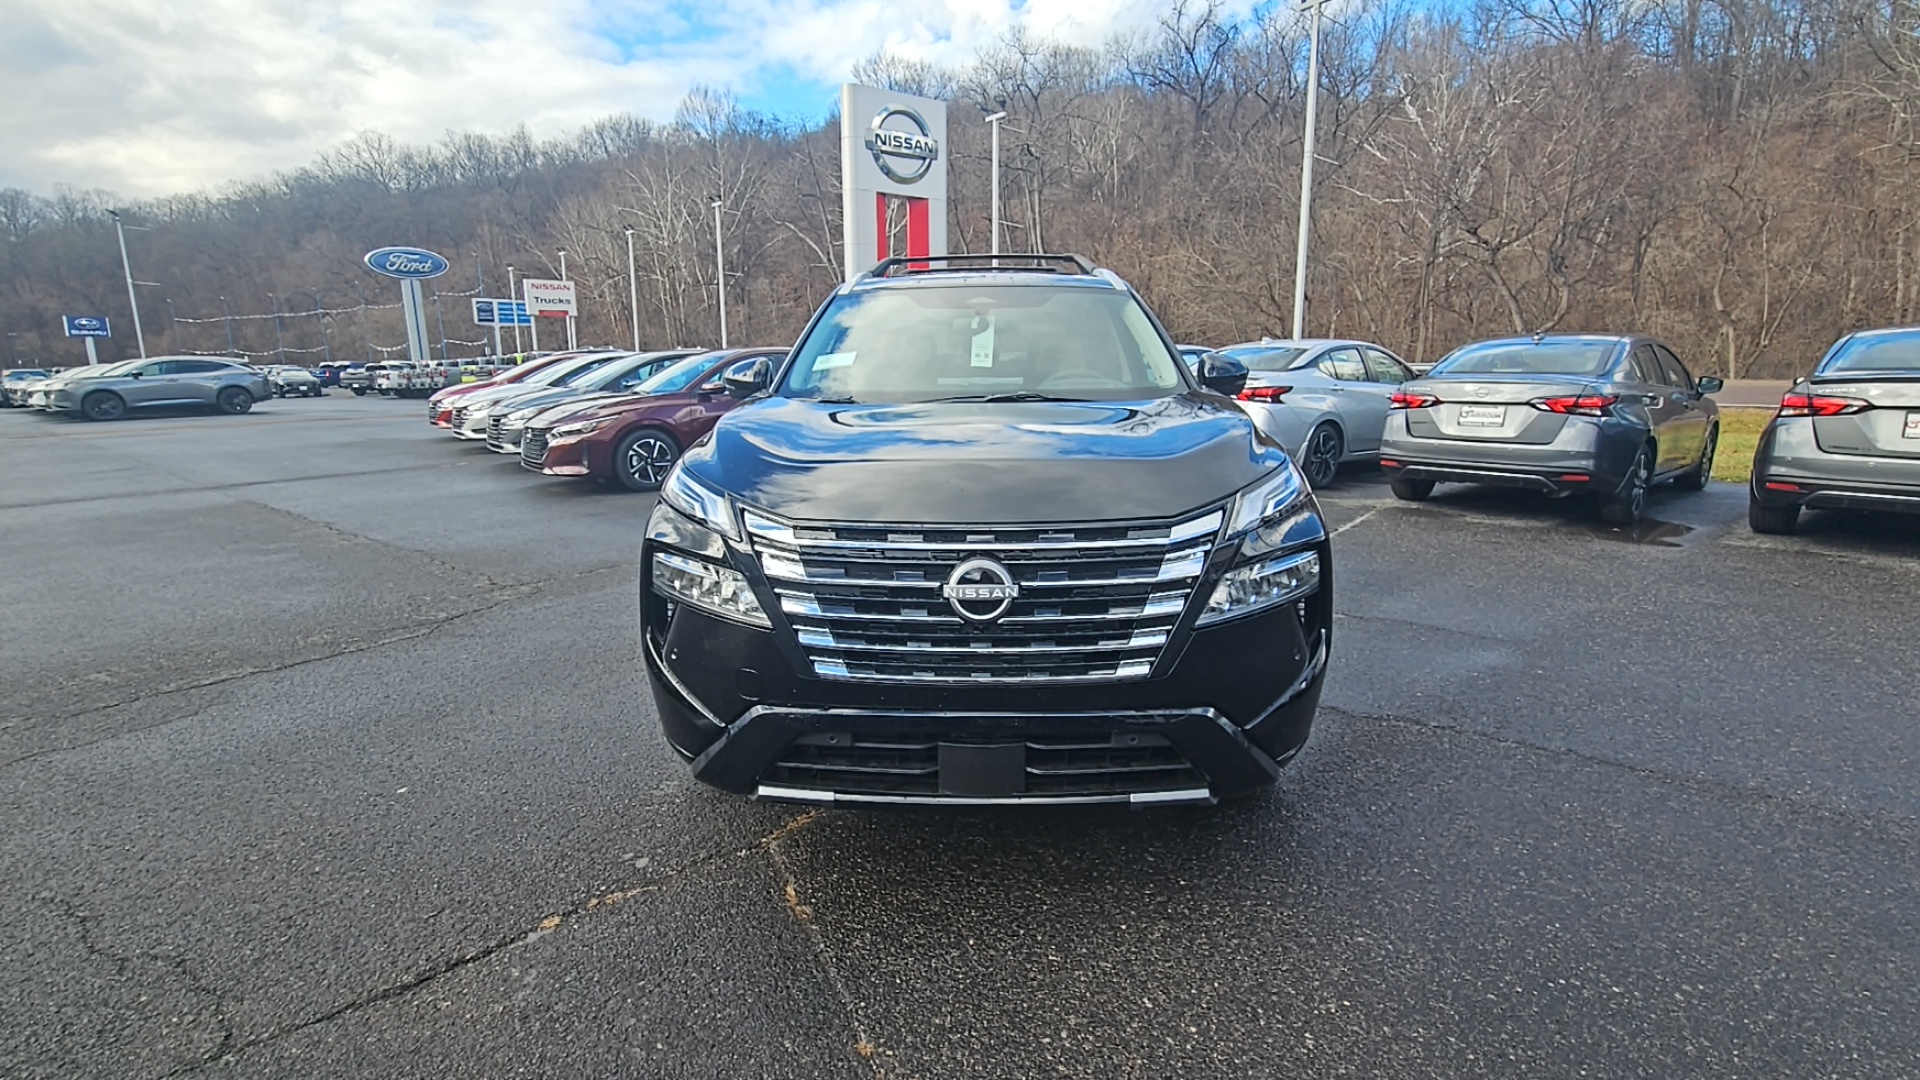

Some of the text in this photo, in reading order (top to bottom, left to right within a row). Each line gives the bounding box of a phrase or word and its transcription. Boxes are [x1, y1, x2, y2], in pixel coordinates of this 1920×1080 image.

[875, 132, 933, 153] NISSAN
[386, 253, 433, 271] Ford
[531, 283, 570, 291] NISSAN
[533, 296, 571, 305] Trucks
[945, 587, 1018, 598] NISSAN
